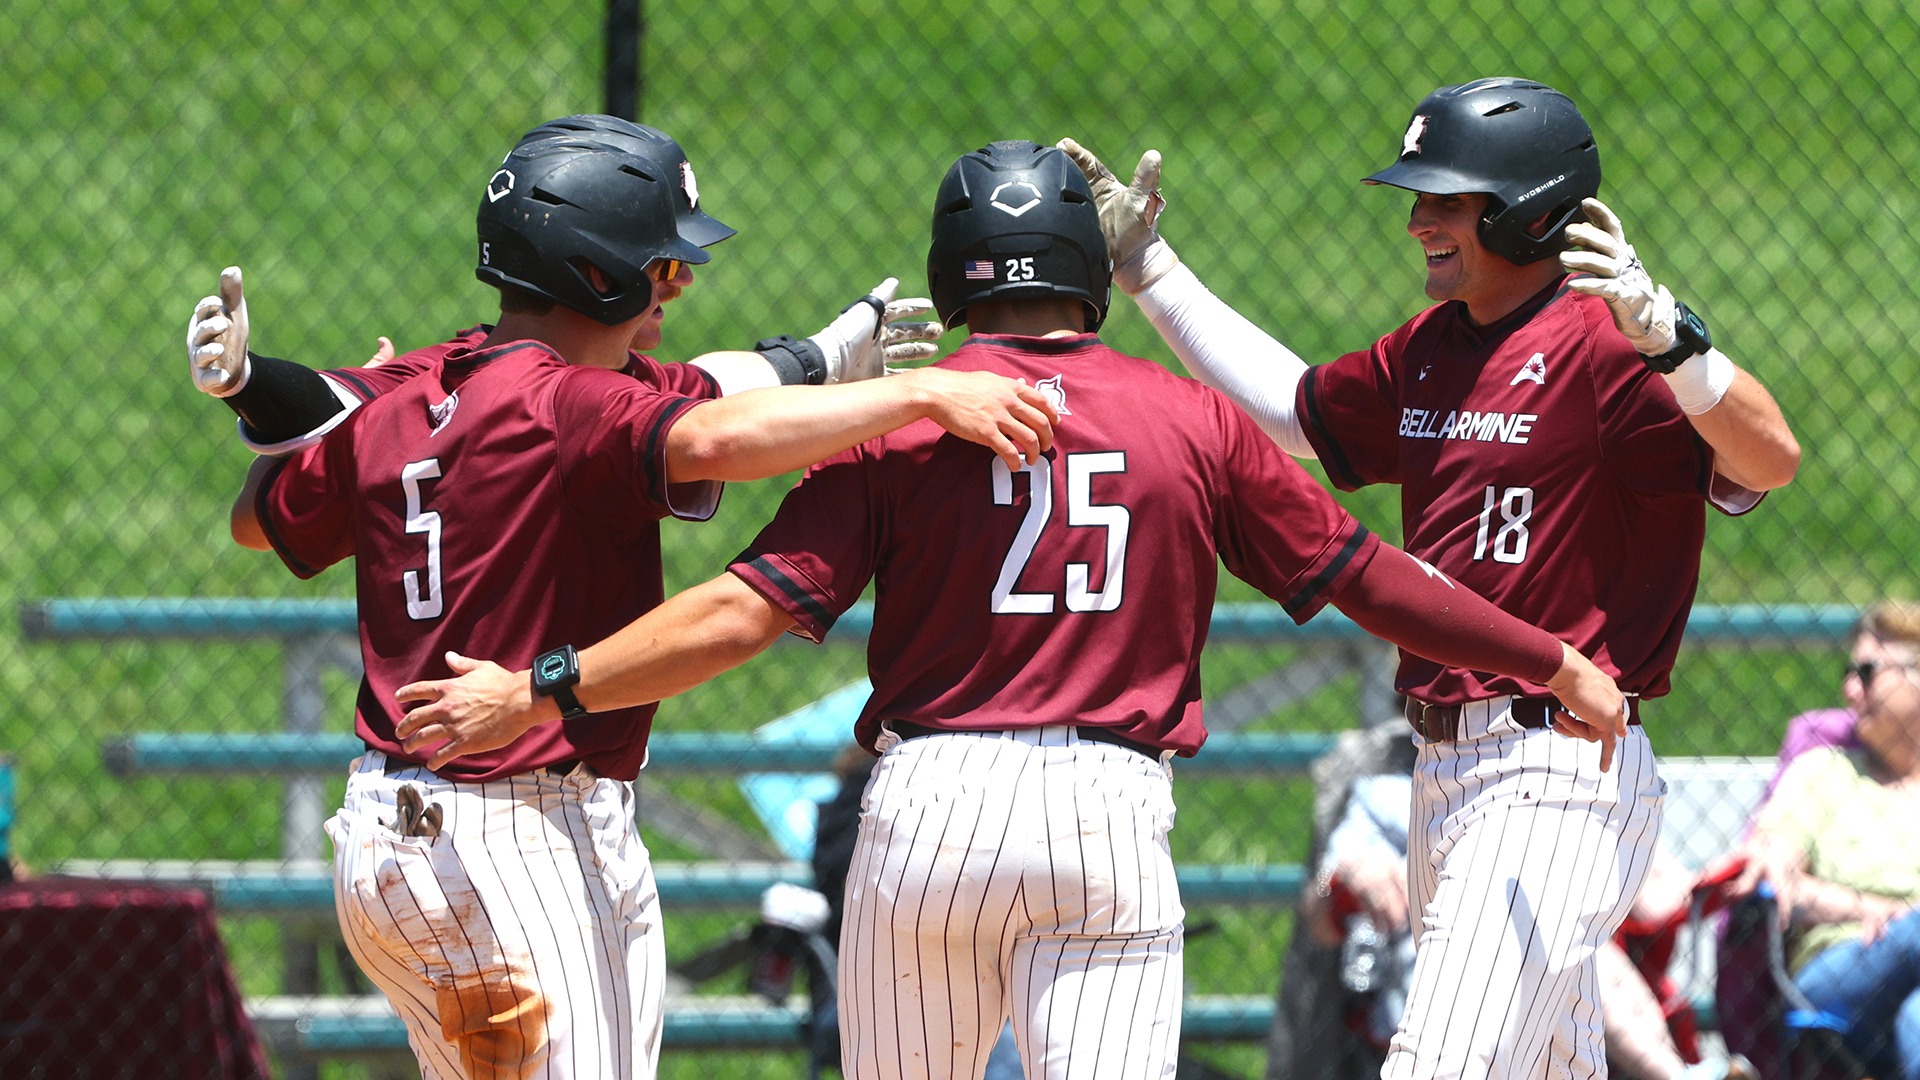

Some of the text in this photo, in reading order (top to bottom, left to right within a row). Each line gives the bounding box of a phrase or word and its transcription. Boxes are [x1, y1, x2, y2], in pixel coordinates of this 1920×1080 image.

[1518, 174, 1565, 201] EVOSHIELD
[483, 242, 490, 265] 5
[1006, 257, 1035, 281] 25
[1399, 407, 1539, 444] BELLARMINE
[402, 457, 444, 620] 5
[990, 450, 1131, 614] 25
[1472, 485, 1535, 565] 18
